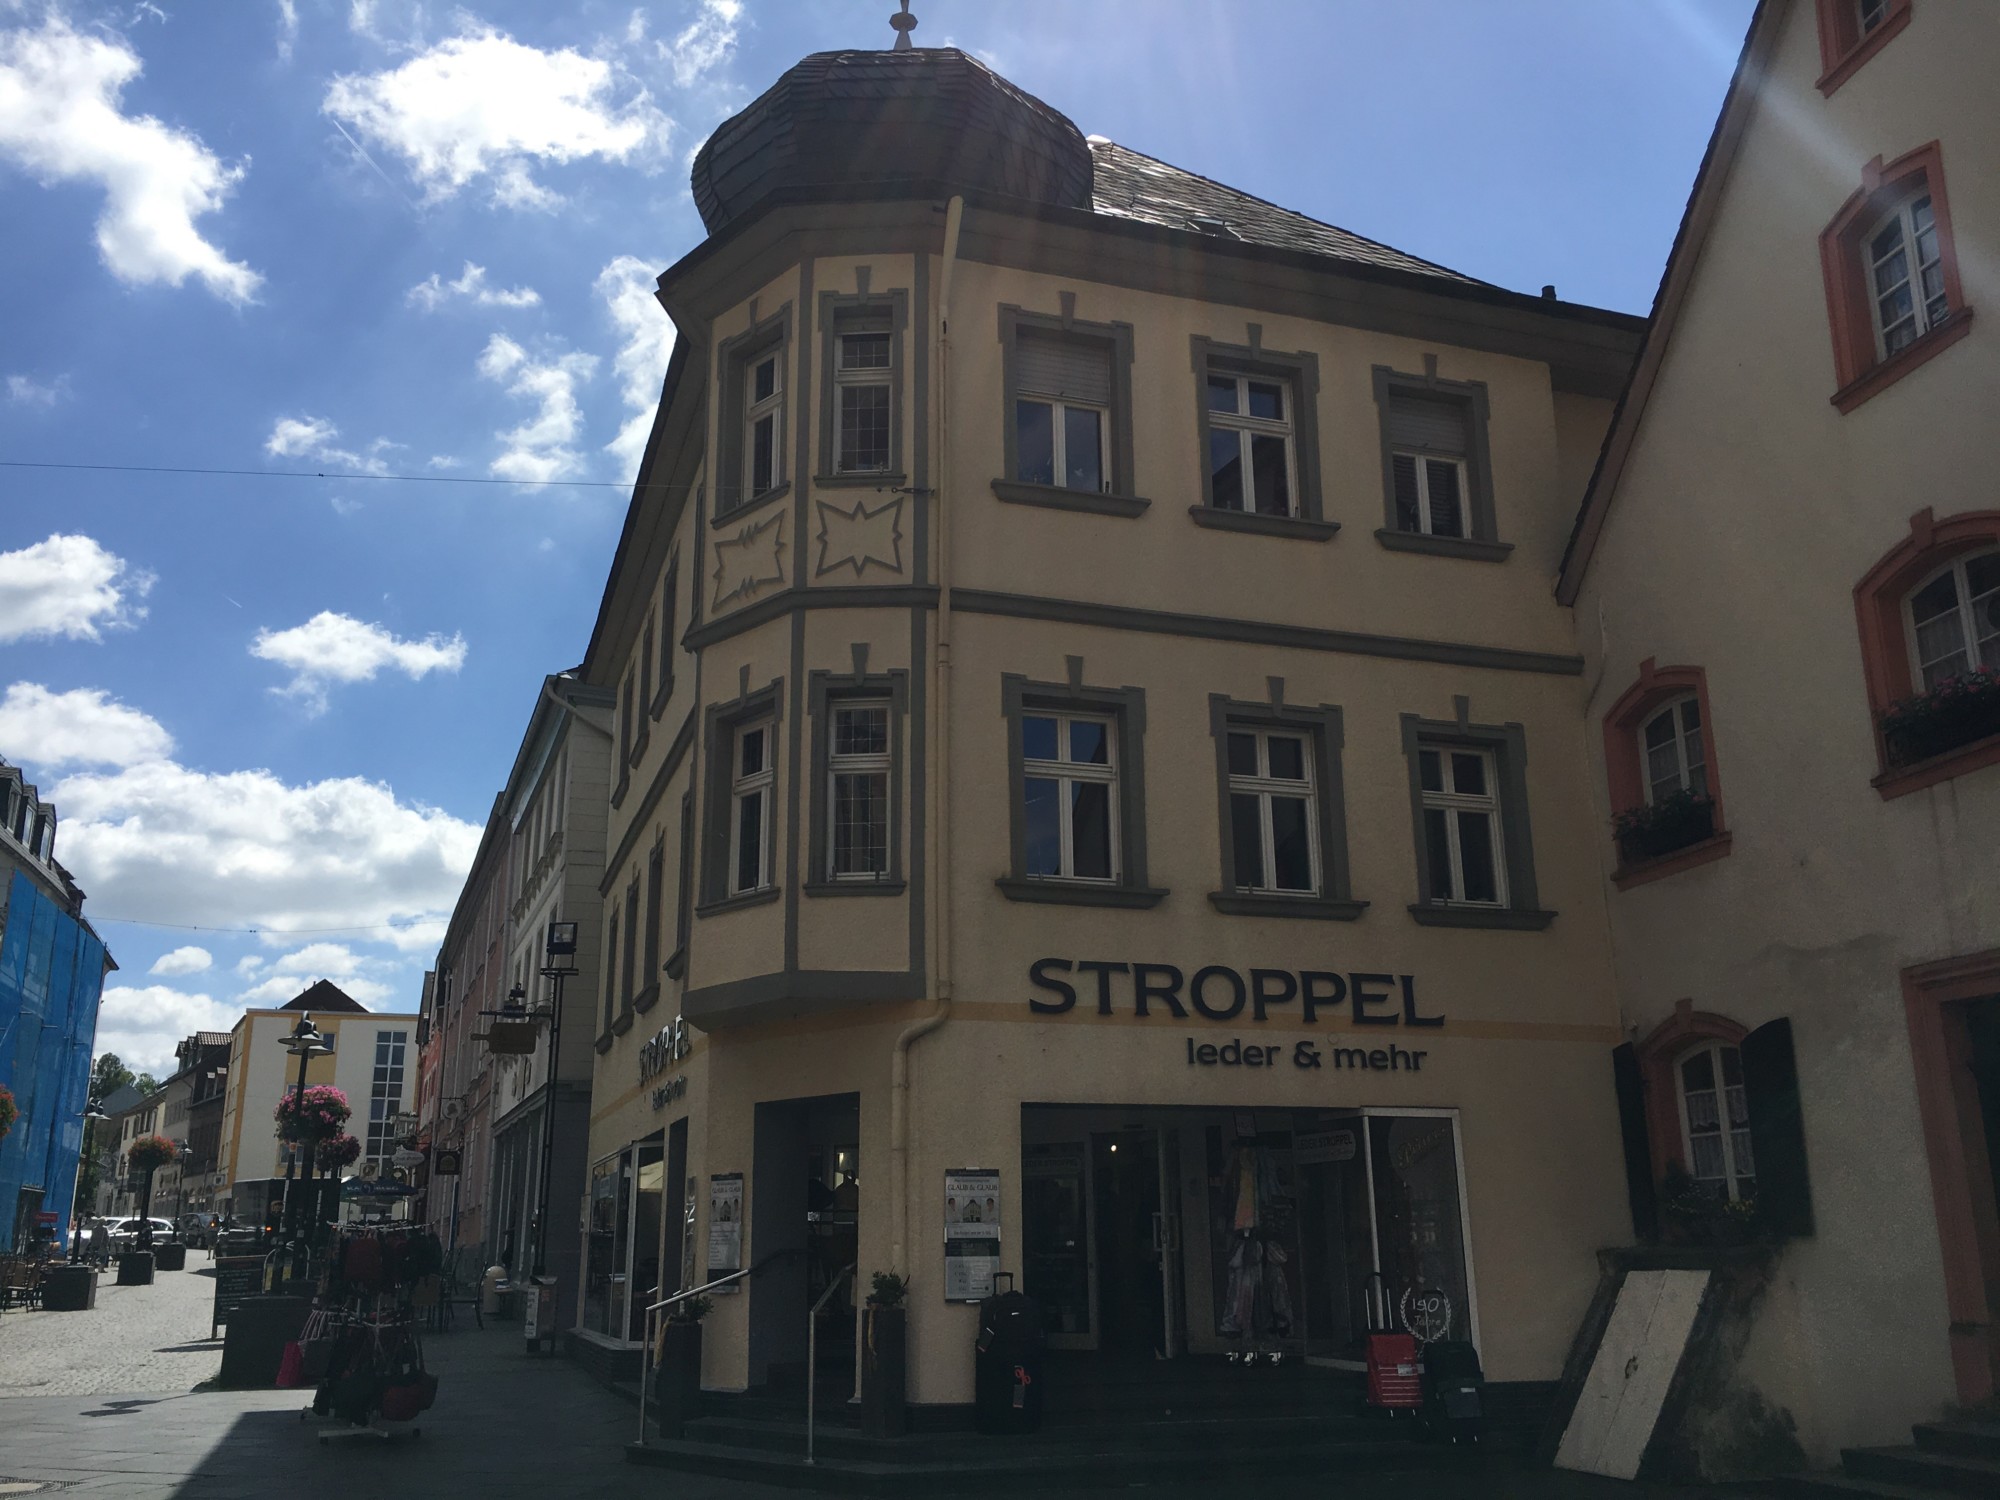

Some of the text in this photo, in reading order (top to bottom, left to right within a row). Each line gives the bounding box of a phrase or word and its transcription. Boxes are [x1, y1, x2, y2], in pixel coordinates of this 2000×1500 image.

[1029, 957, 1446, 1027] STROPPEL
[1187, 1037, 1428, 1071] leder & mehr
